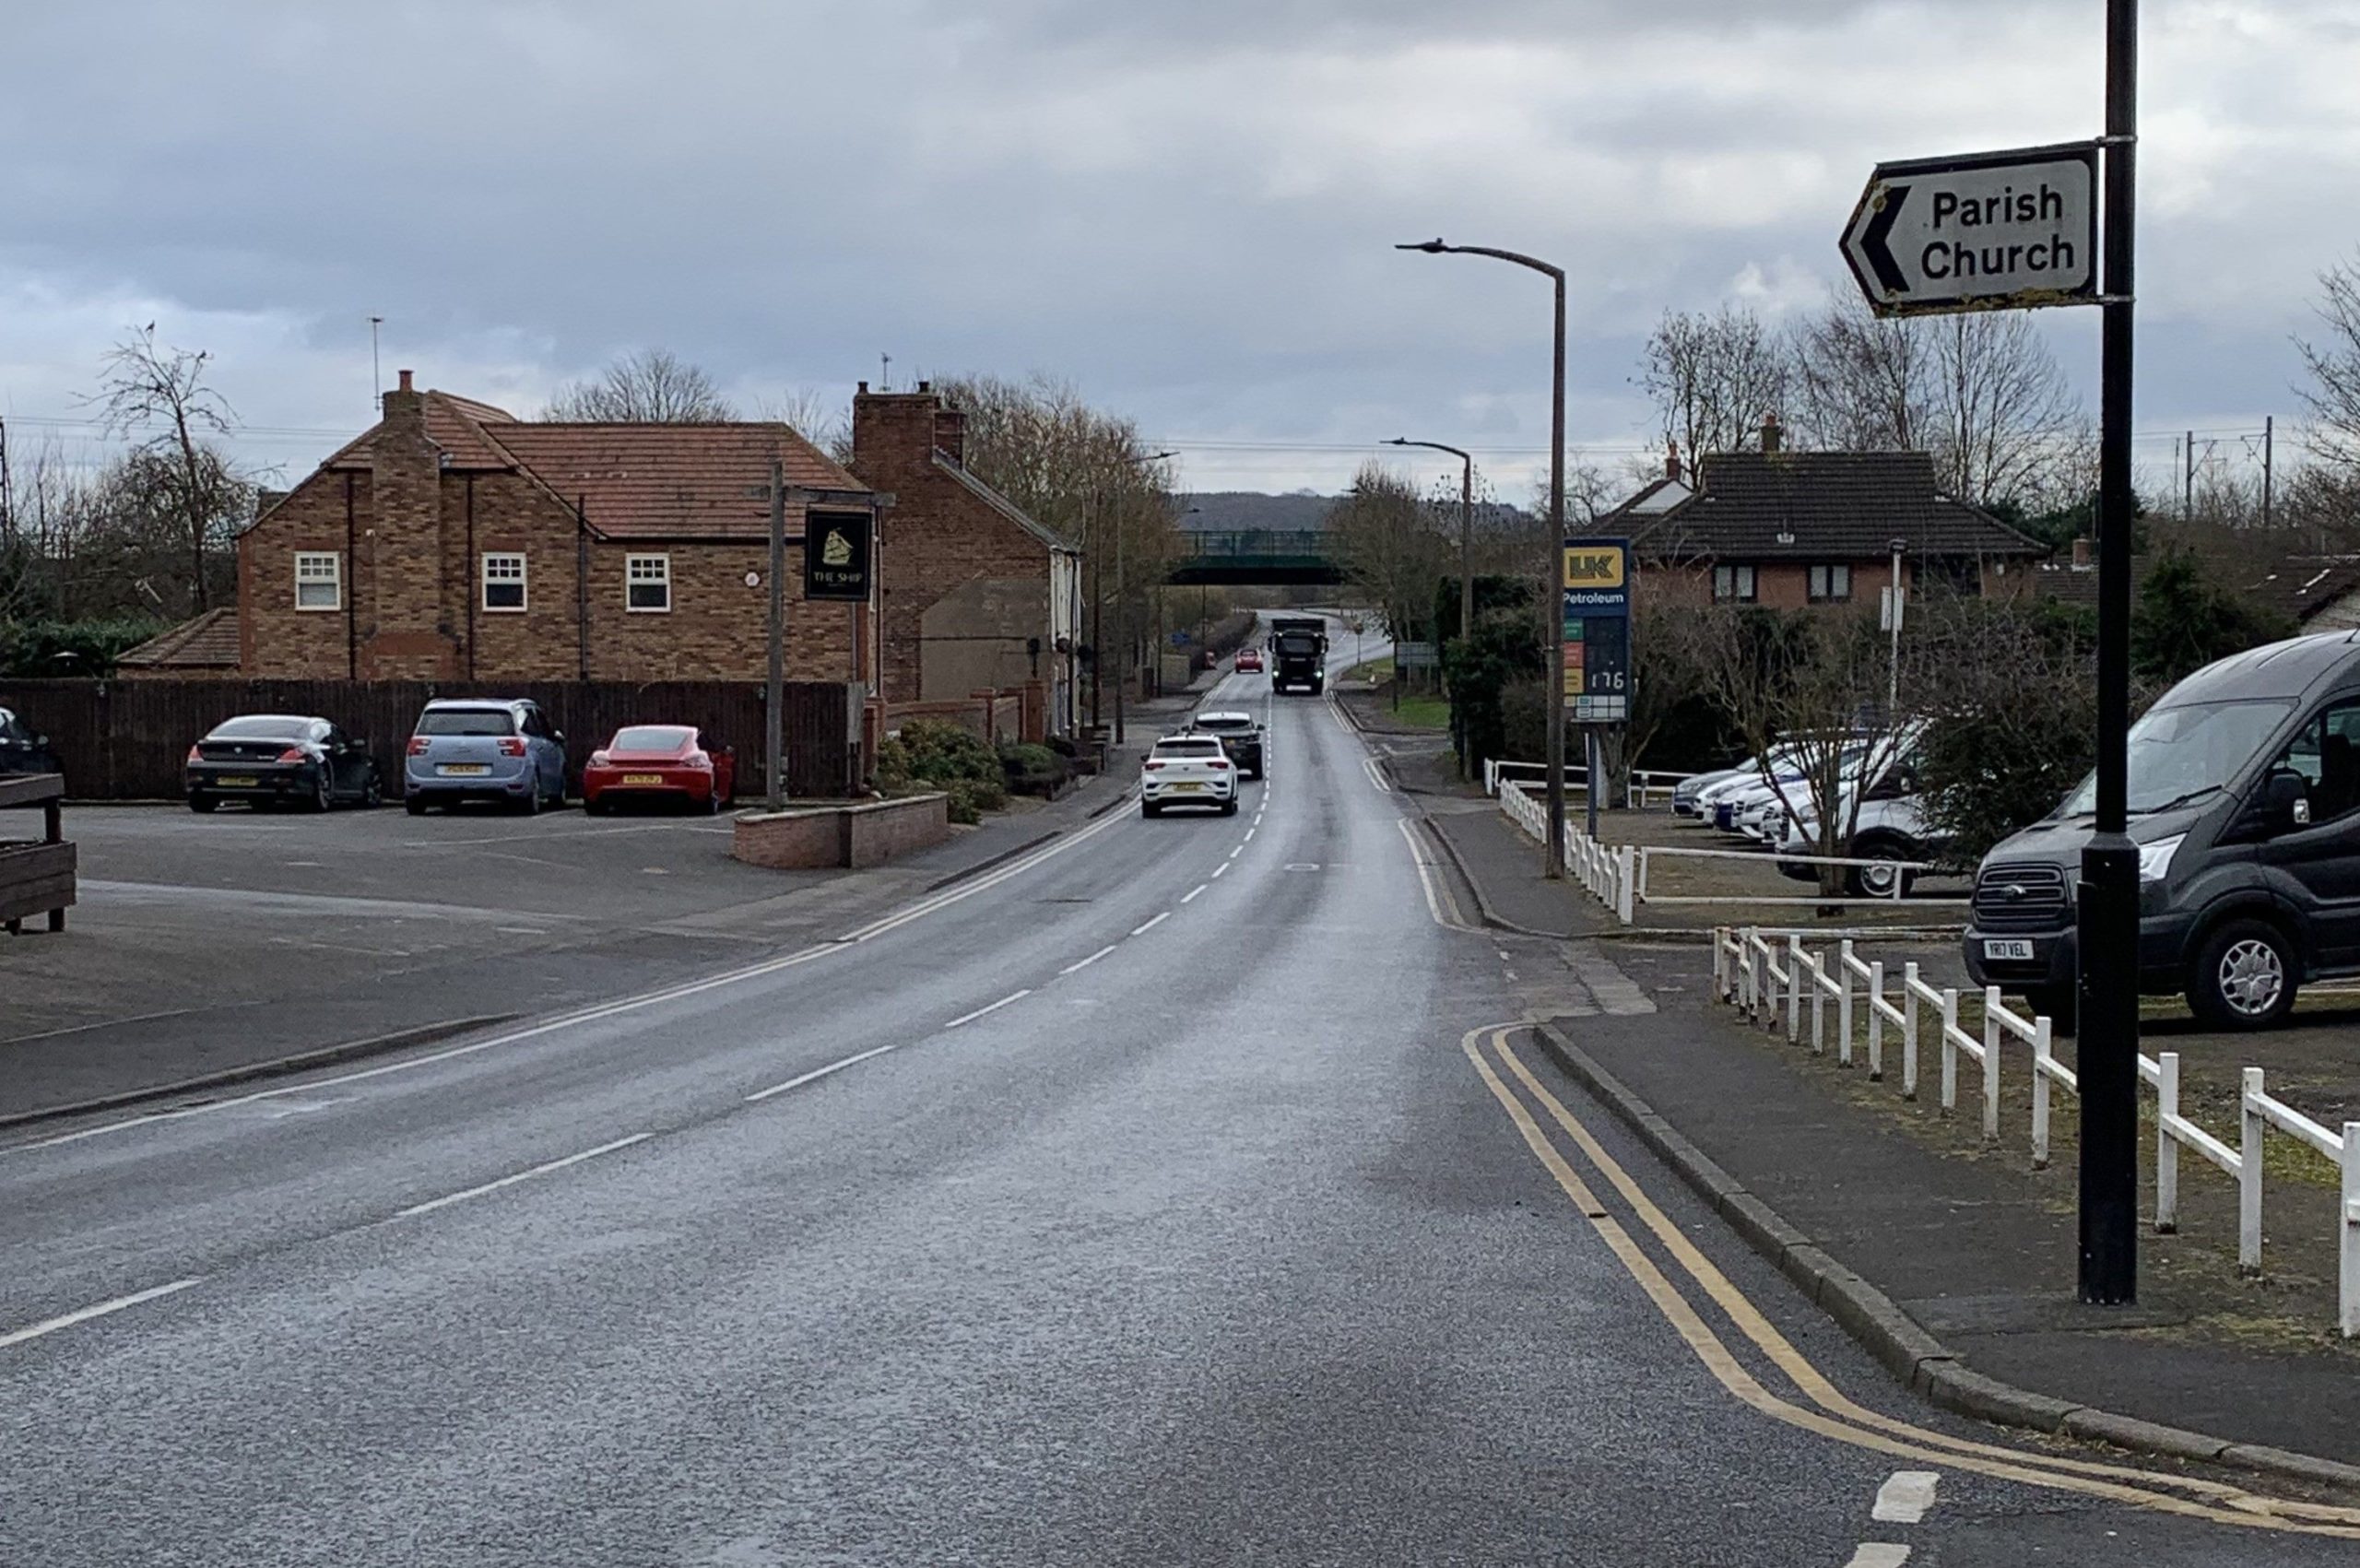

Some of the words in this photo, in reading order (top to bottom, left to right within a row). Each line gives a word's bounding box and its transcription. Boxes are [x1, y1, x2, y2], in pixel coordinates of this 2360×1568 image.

[1932, 183, 2063, 229] Parish
[1921, 233, 2074, 279] Church
[813, 572, 833, 583] THE
[837, 572, 863, 583] SHIP
[1569, 555, 1614, 579] UK
[1563, 592, 1624, 604] Petroleum
